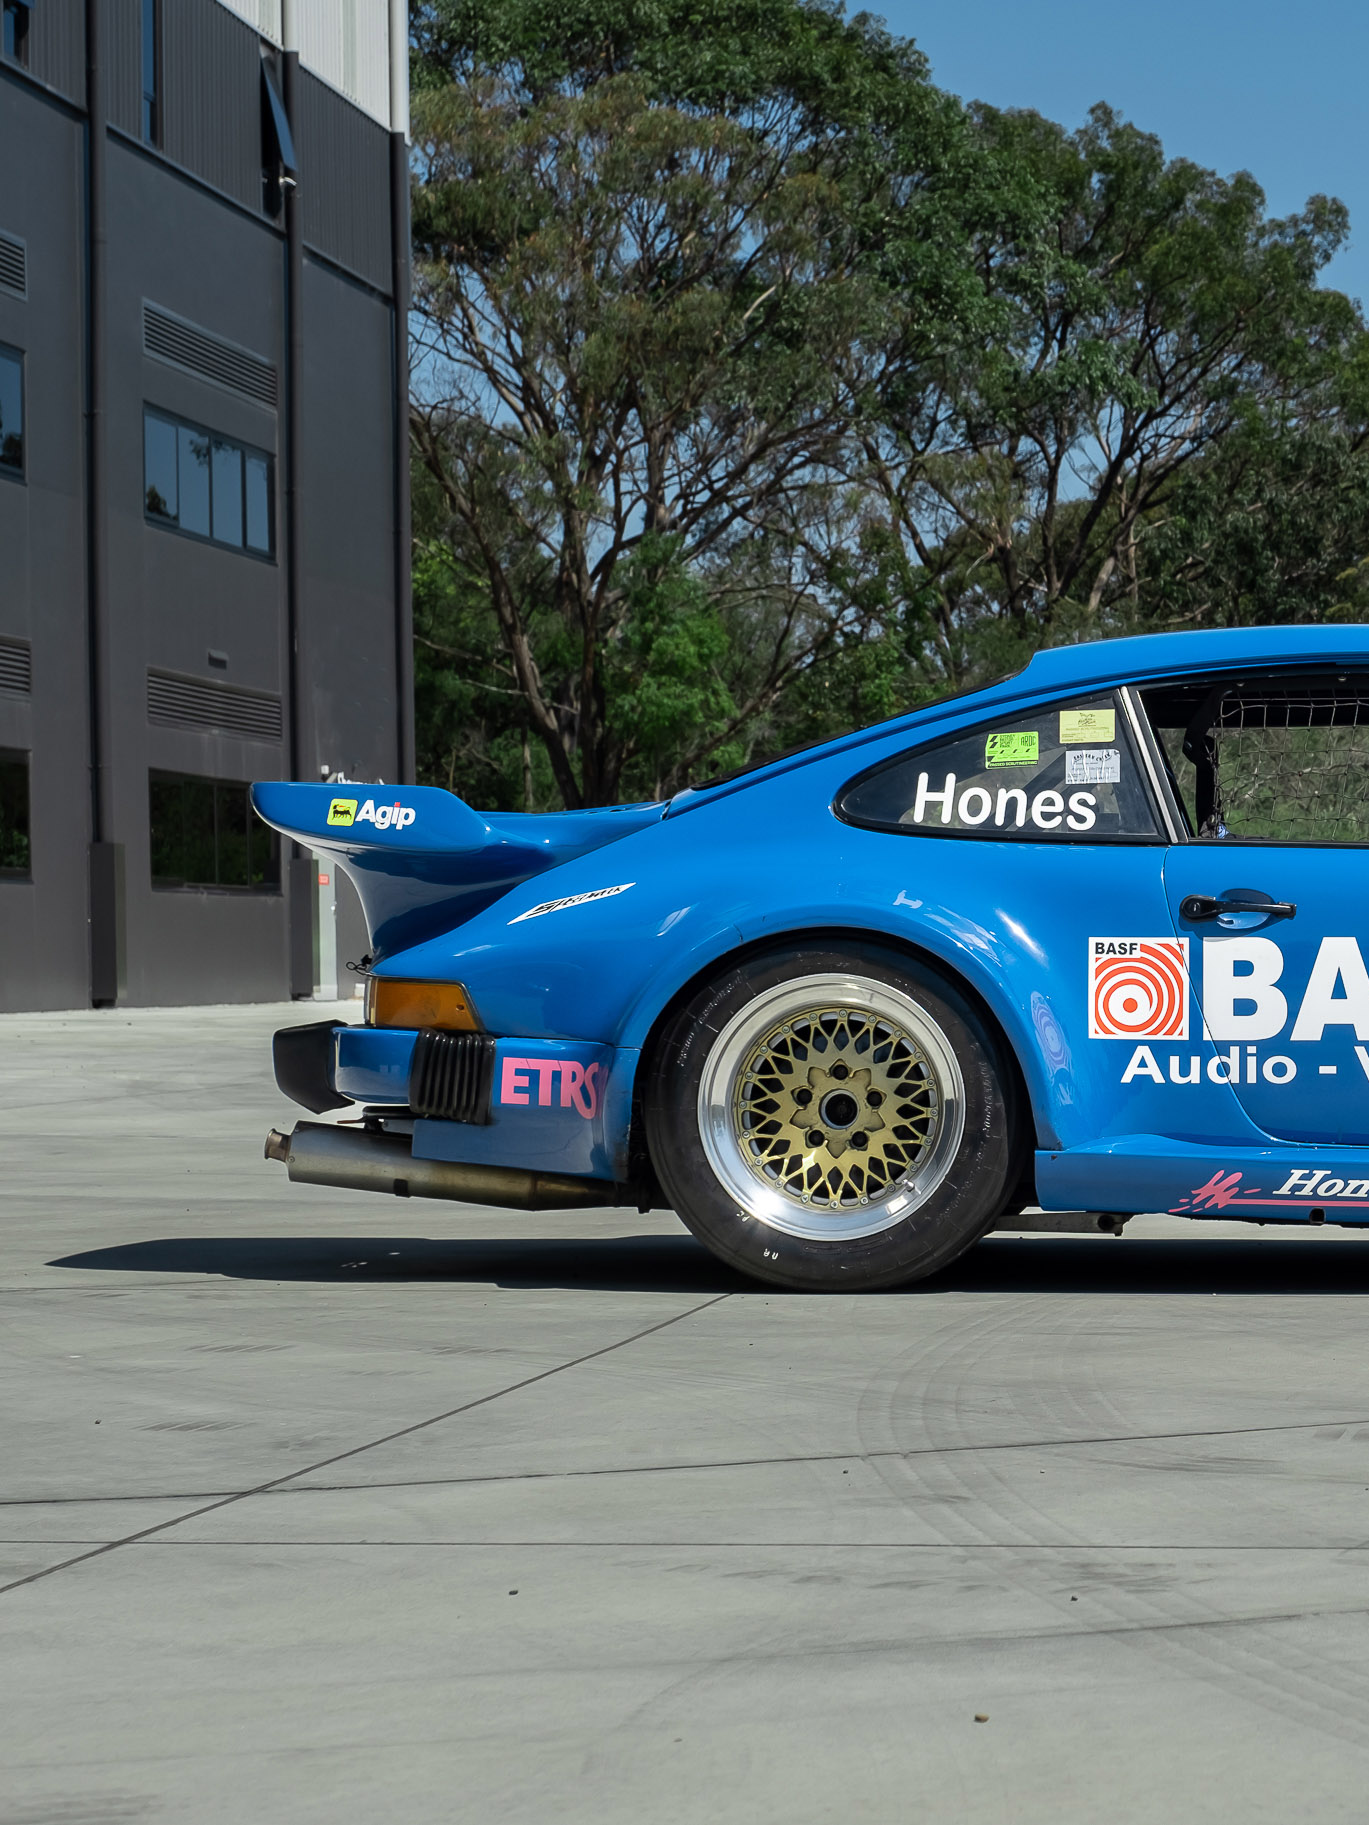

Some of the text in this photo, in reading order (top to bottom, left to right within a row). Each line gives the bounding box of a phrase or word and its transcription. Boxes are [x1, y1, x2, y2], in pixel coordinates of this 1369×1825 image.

[355, 799, 416, 830] Agip
[913, 772, 1097, 831] Hones
[1095, 942, 1139, 956] BASF
[1120, 1045, 1297, 1085] Audio
